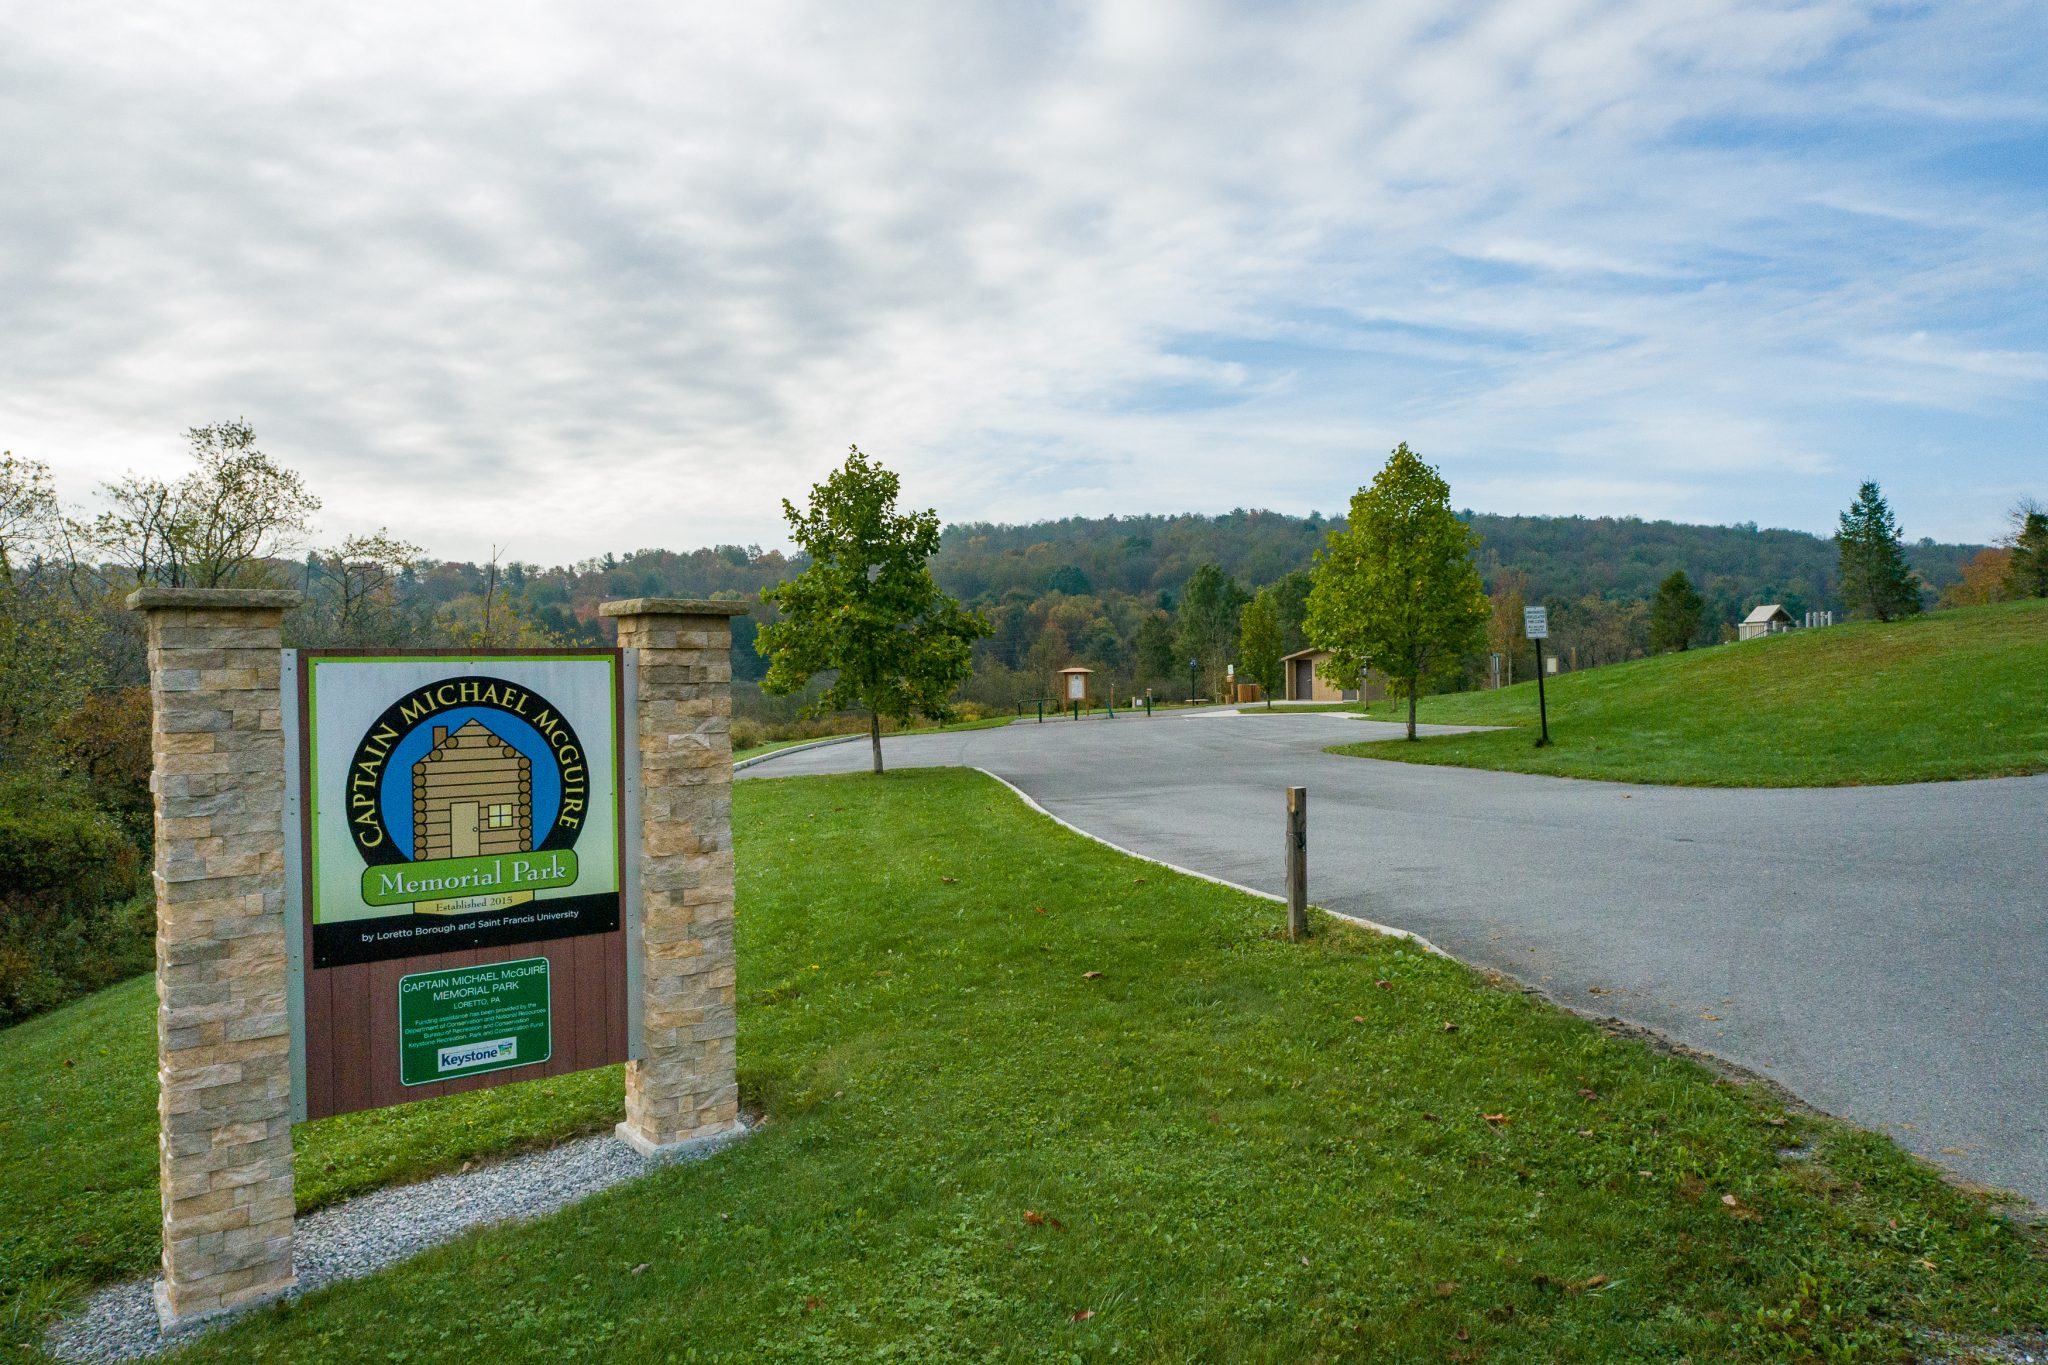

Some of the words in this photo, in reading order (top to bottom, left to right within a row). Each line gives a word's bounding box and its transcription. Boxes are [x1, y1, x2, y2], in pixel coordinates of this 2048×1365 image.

[353, 722, 399, 848] CAPTAIN
[400, 682, 530, 725] MICHAEL
[378, 860, 502, 896] Memorial
[512, 854, 567, 883] Park
[436, 898, 487, 912] Established
[490, 896, 513, 906] 2015
[361, 933, 374, 943] by
[377, 929, 412, 940] Loretto
[415, 924, 456, 935] Borough
[458, 921, 476, 931] and
[478, 918, 500, 929] Saint
[503, 914, 535, 925] Francis
[536, 910, 579, 922] University
[403, 979, 449, 993] CAPTAIN
[452, 972, 499, 986] MICHAEL
[501, 965, 546, 979] McGUIRE
[433, 985, 490, 1001] MEMORIAL
[492, 981, 520, 992] PARK
[441, 1049, 498, 1066] Keystone
